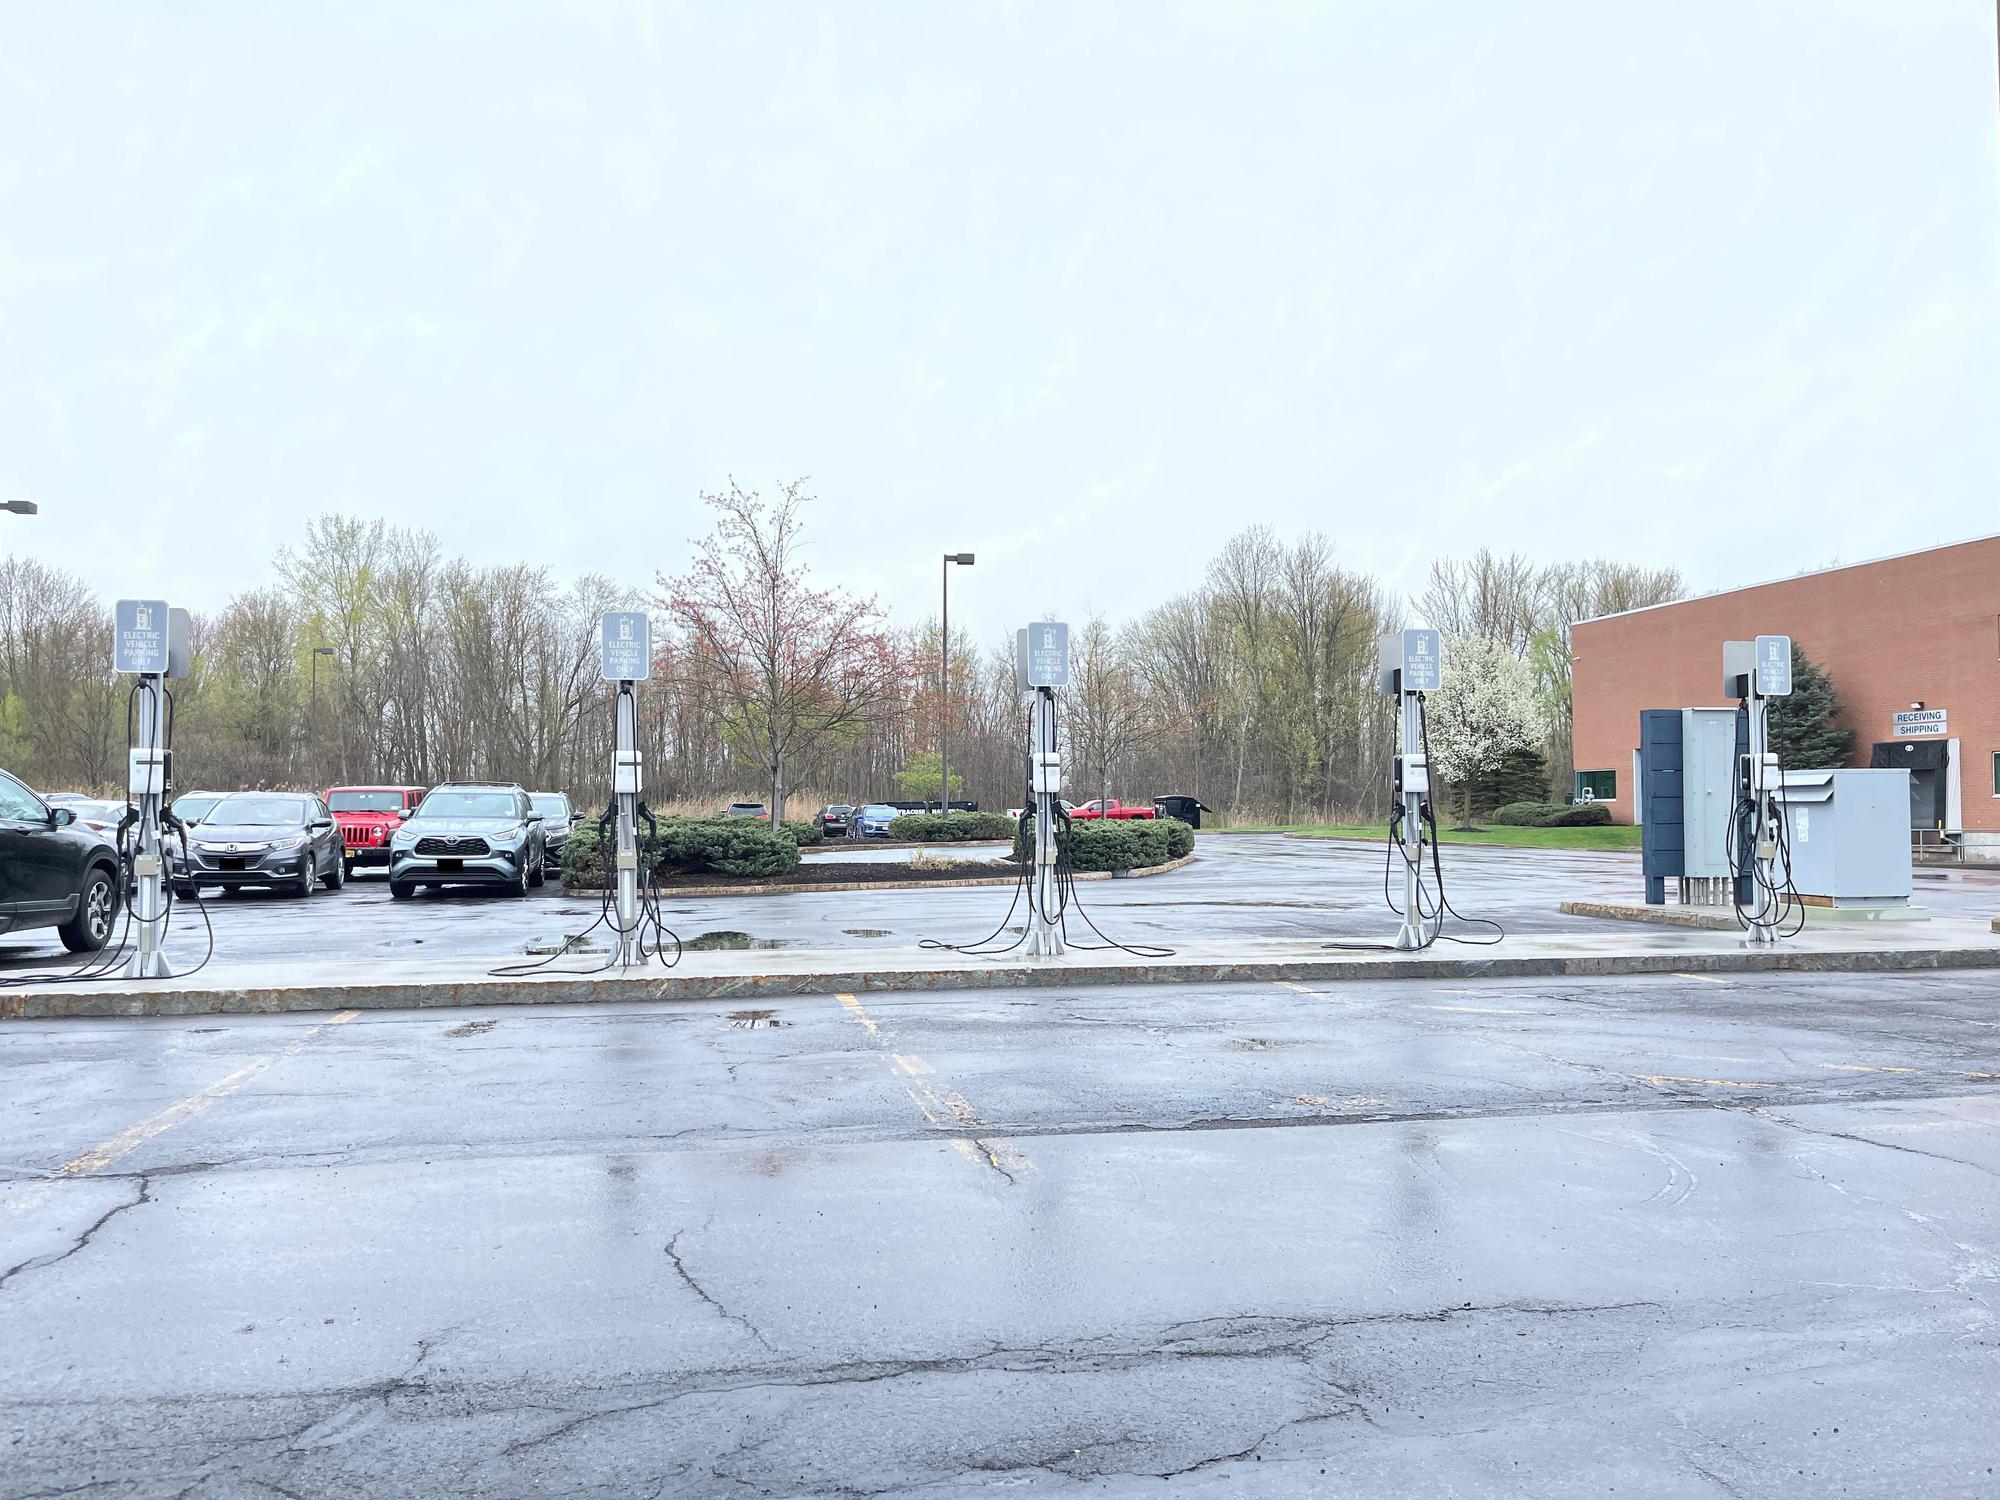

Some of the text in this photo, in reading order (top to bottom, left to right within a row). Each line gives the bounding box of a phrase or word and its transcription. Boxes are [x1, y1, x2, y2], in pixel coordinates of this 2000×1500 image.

[123, 631, 161, 639] ELECTRIC
[125, 640, 159, 648] VEHICLE
[123, 648, 159, 657] PARKING
[131, 657, 152, 665] ONLY
[616, 665, 633, 673] ONLY
[1897, 711, 1941, 722] RECEIVING
[1900, 724, 1939, 734] SHIPPING
